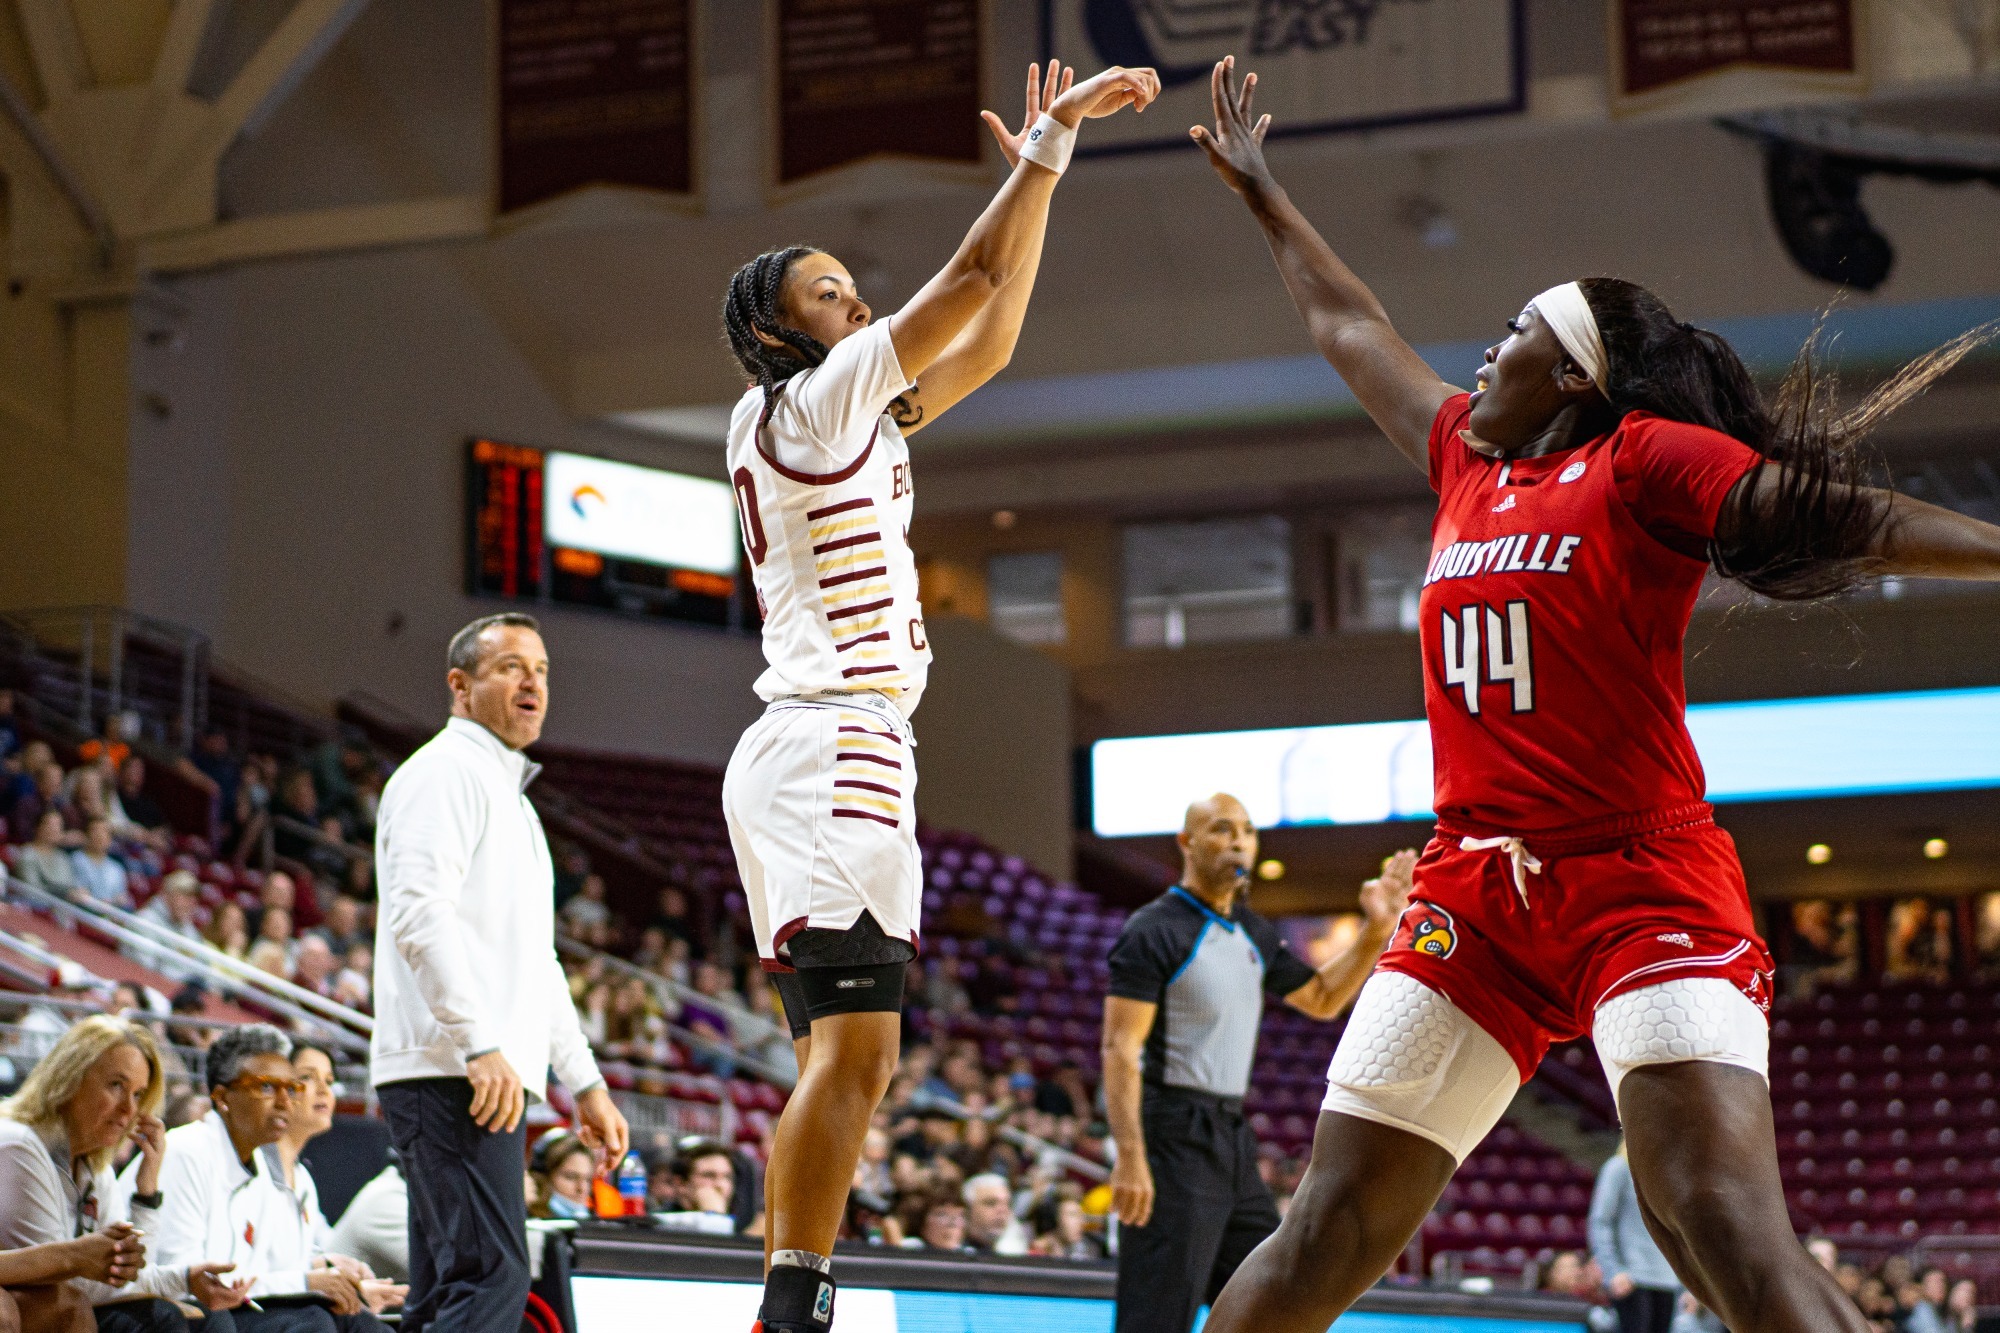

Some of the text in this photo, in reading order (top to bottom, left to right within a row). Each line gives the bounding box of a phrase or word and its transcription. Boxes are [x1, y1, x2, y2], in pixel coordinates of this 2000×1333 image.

[1423, 533, 1582, 588] LOUISVILLE
[1441, 598, 1535, 716] 44
[1657, 934, 1694, 949] adidas
